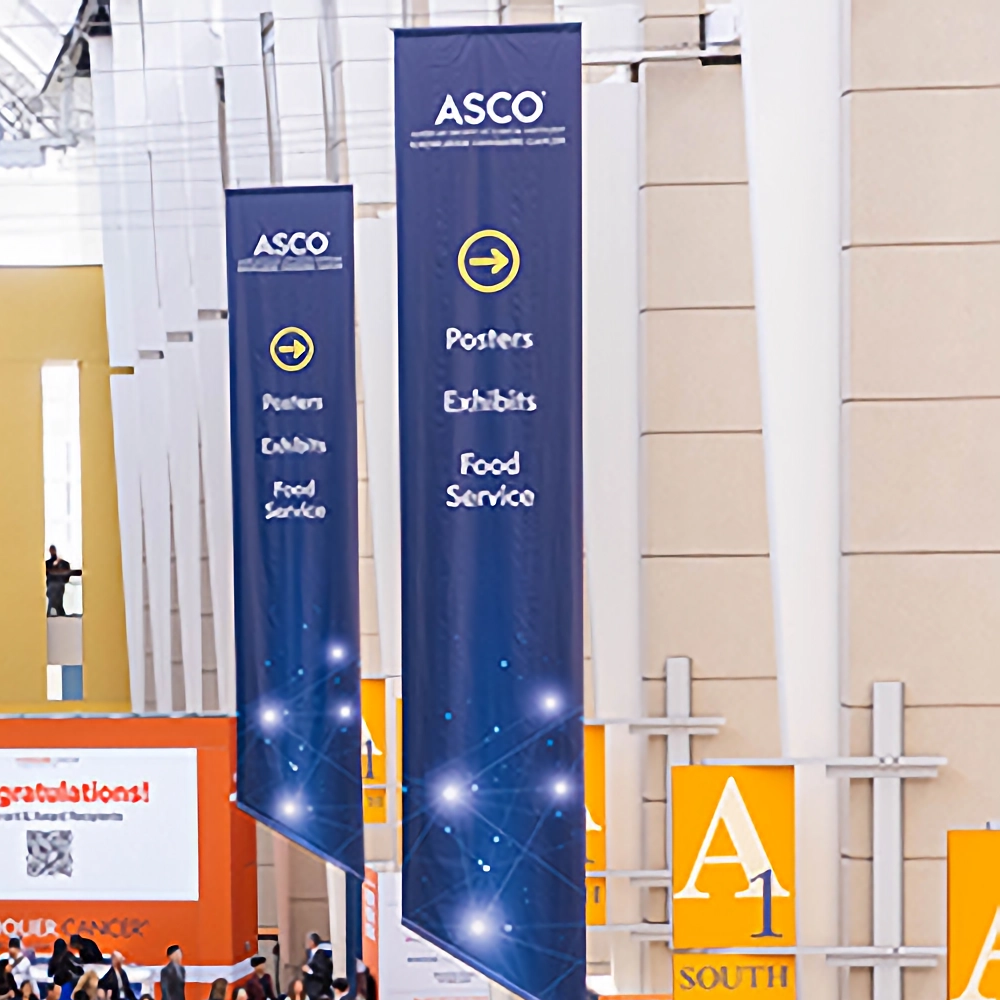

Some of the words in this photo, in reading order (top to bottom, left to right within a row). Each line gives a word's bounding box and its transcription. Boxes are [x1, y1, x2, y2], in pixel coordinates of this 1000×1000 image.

[434, 90, 544, 125] ASCO
[253, 231, 329, 256] ASCO
[445, 327, 534, 352] Posters
[443, 389, 538, 414] Exhibits
[460, 451, 520, 476] Food
[445, 485, 535, 508] Service
[679, 965, 789, 991] SOUTH
